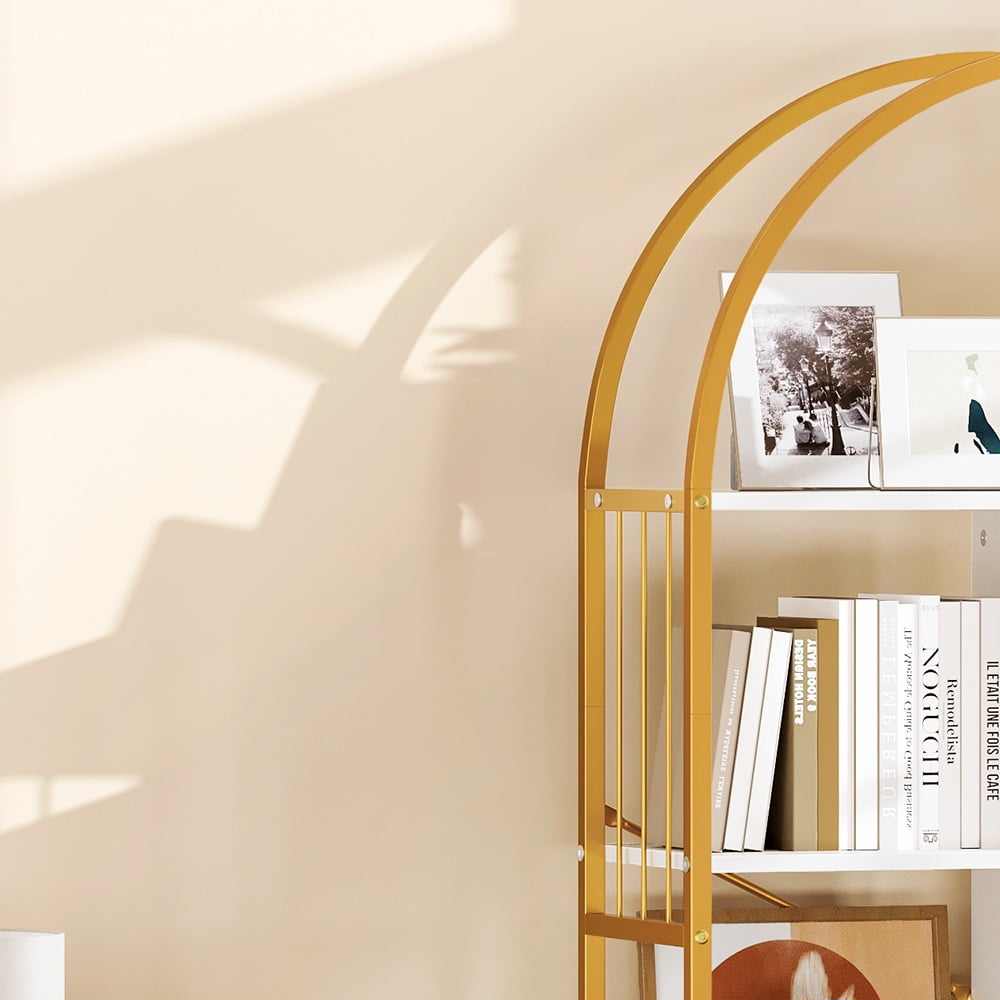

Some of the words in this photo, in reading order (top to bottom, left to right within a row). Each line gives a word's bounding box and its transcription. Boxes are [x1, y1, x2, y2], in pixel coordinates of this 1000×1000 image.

[986, 660, 1000, 671] IL
[922, 647, 940, 787] NOGUCHI
[946, 678, 959, 765] Remodelista
[986, 707, 1000, 728] UNE
[986, 731, 1000, 755] FOIS
[986, 758, 1000, 771] LE
